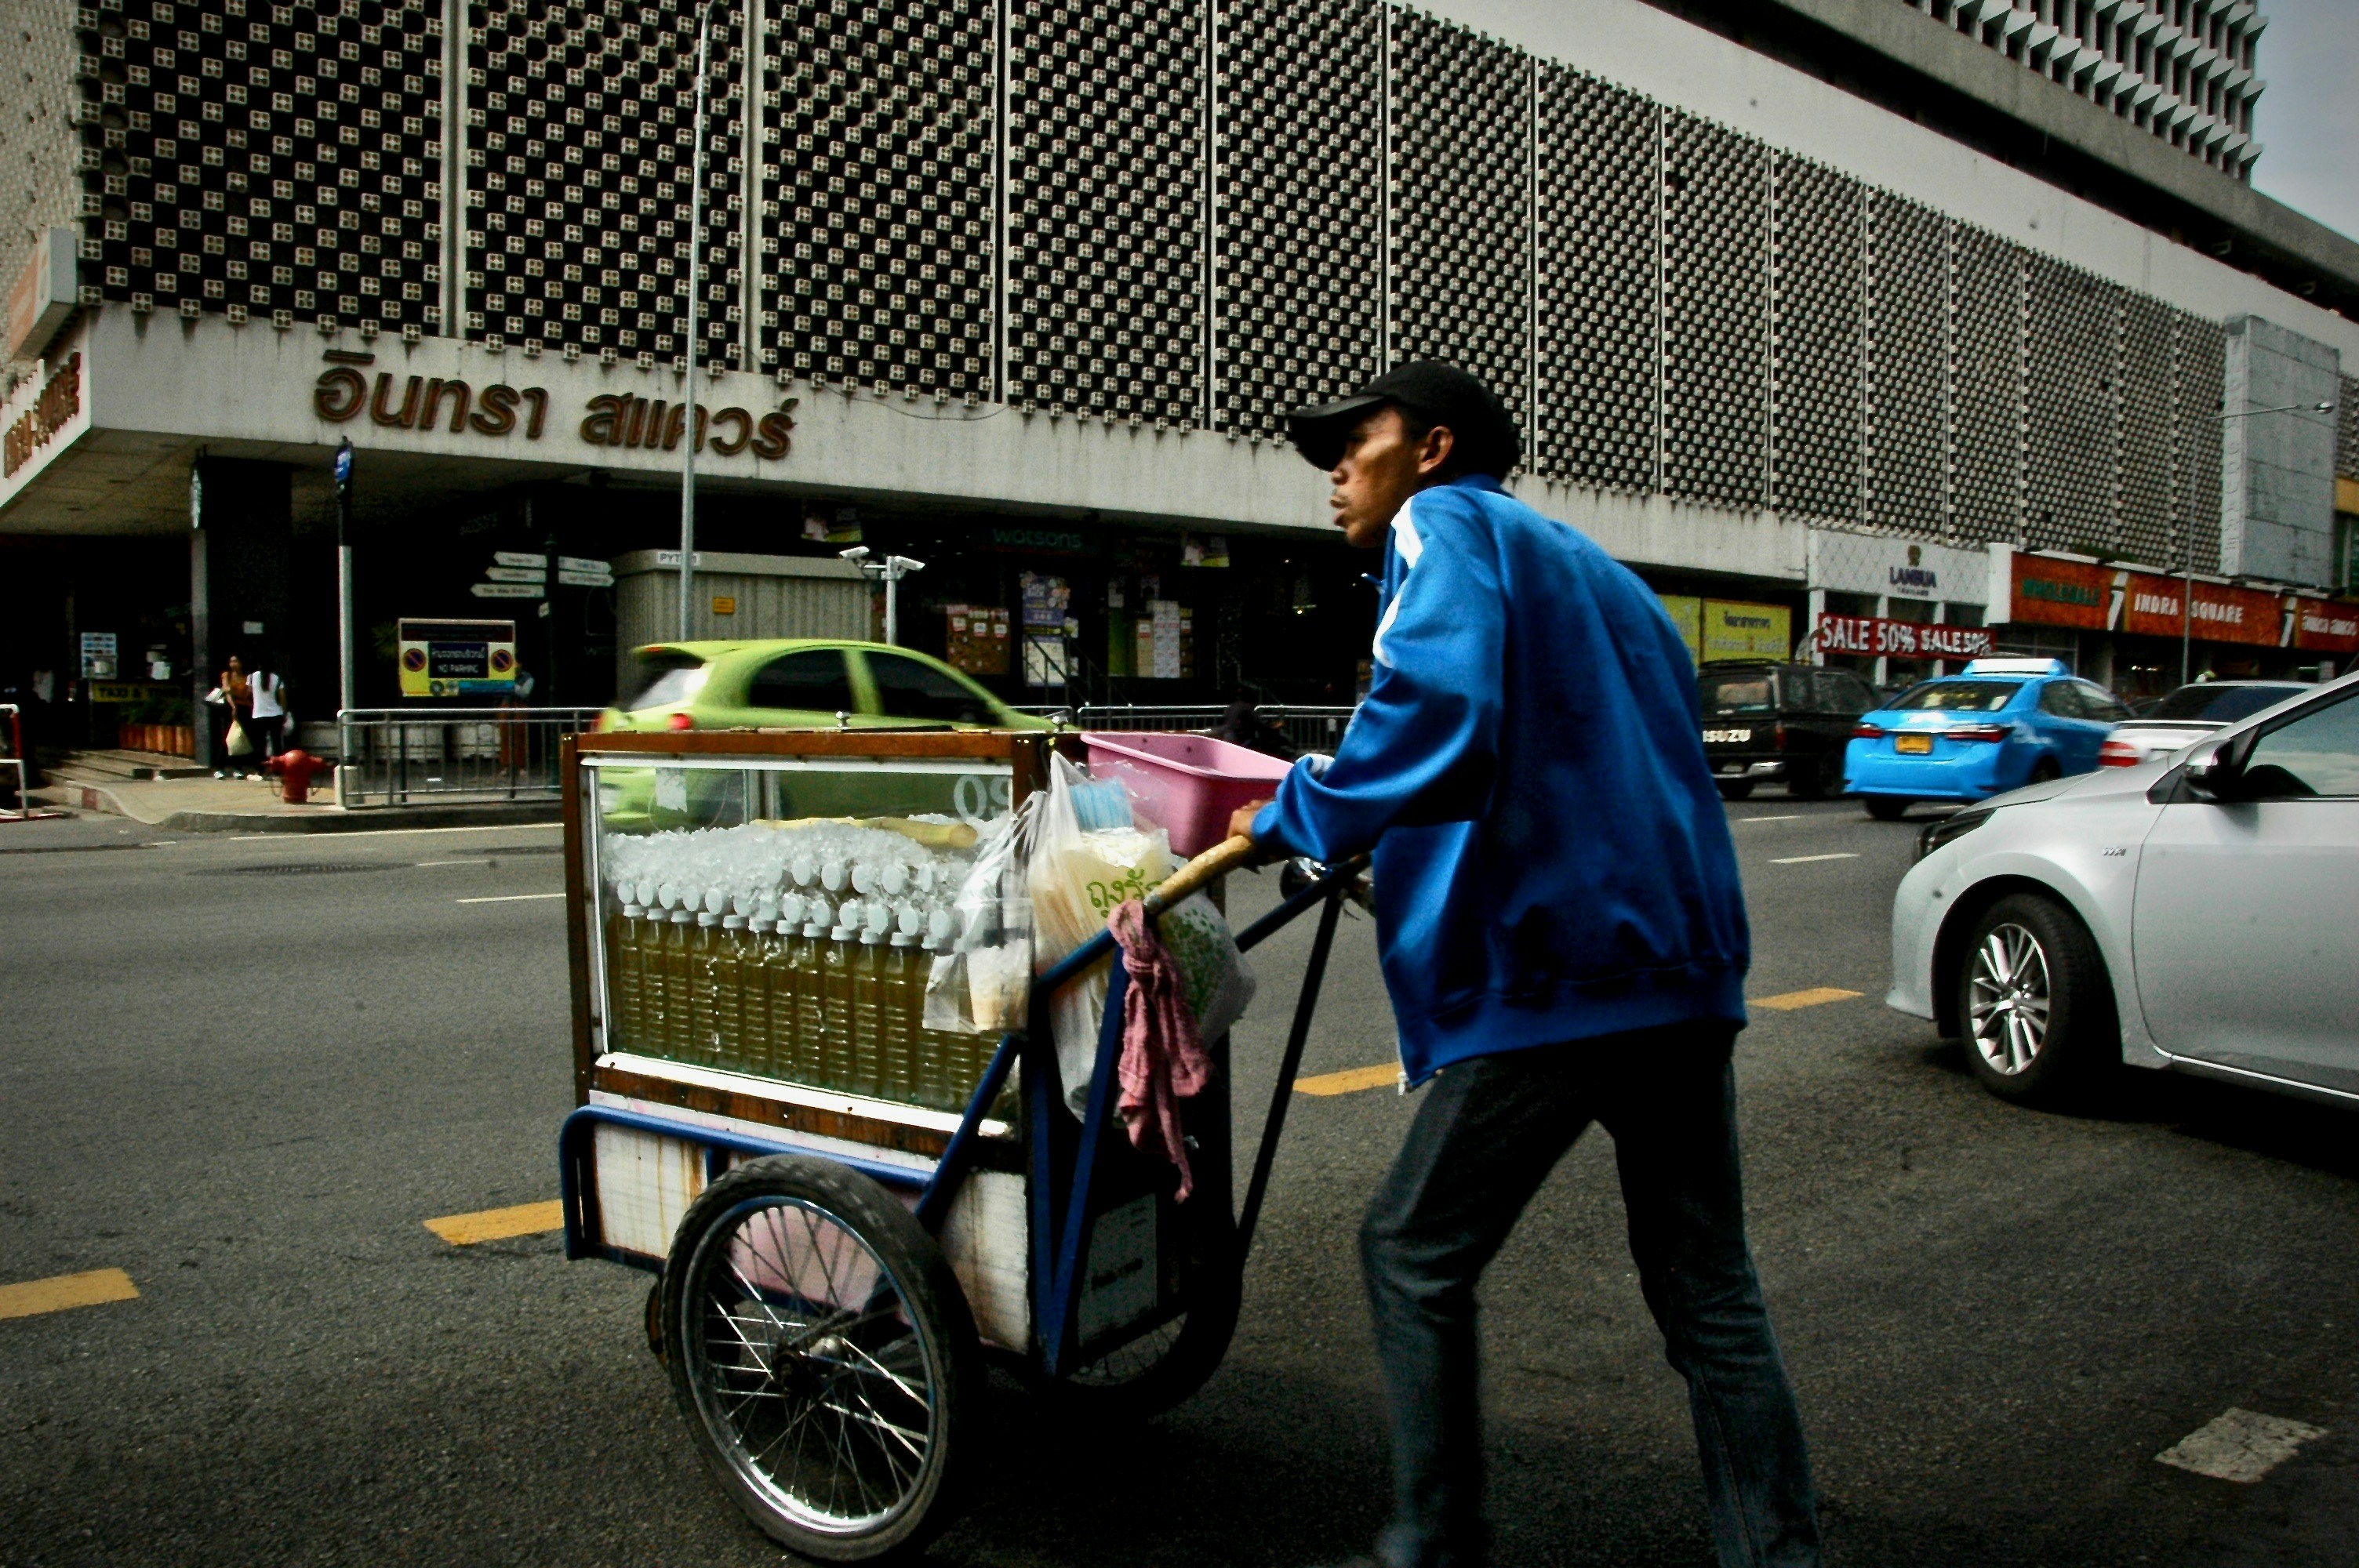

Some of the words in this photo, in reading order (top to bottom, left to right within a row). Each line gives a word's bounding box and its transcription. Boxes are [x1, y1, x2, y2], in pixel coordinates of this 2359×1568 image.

[314, 350, 549, 439] อินทรา
[580, 392, 799, 460] สแควร์
[994, 528, 1081, 548] watsons
[2023, 579, 2099, 604] WHOLESALE
[2134, 593, 2179, 616] INDRA
[2190, 601, 2244, 624] SQUARE
[1820, 616, 1870, 651] SALE
[1877, 622, 1916, 653] 50%
[1921, 629, 1961, 653] SALE
[1703, 728, 1751, 742] ISUZU
